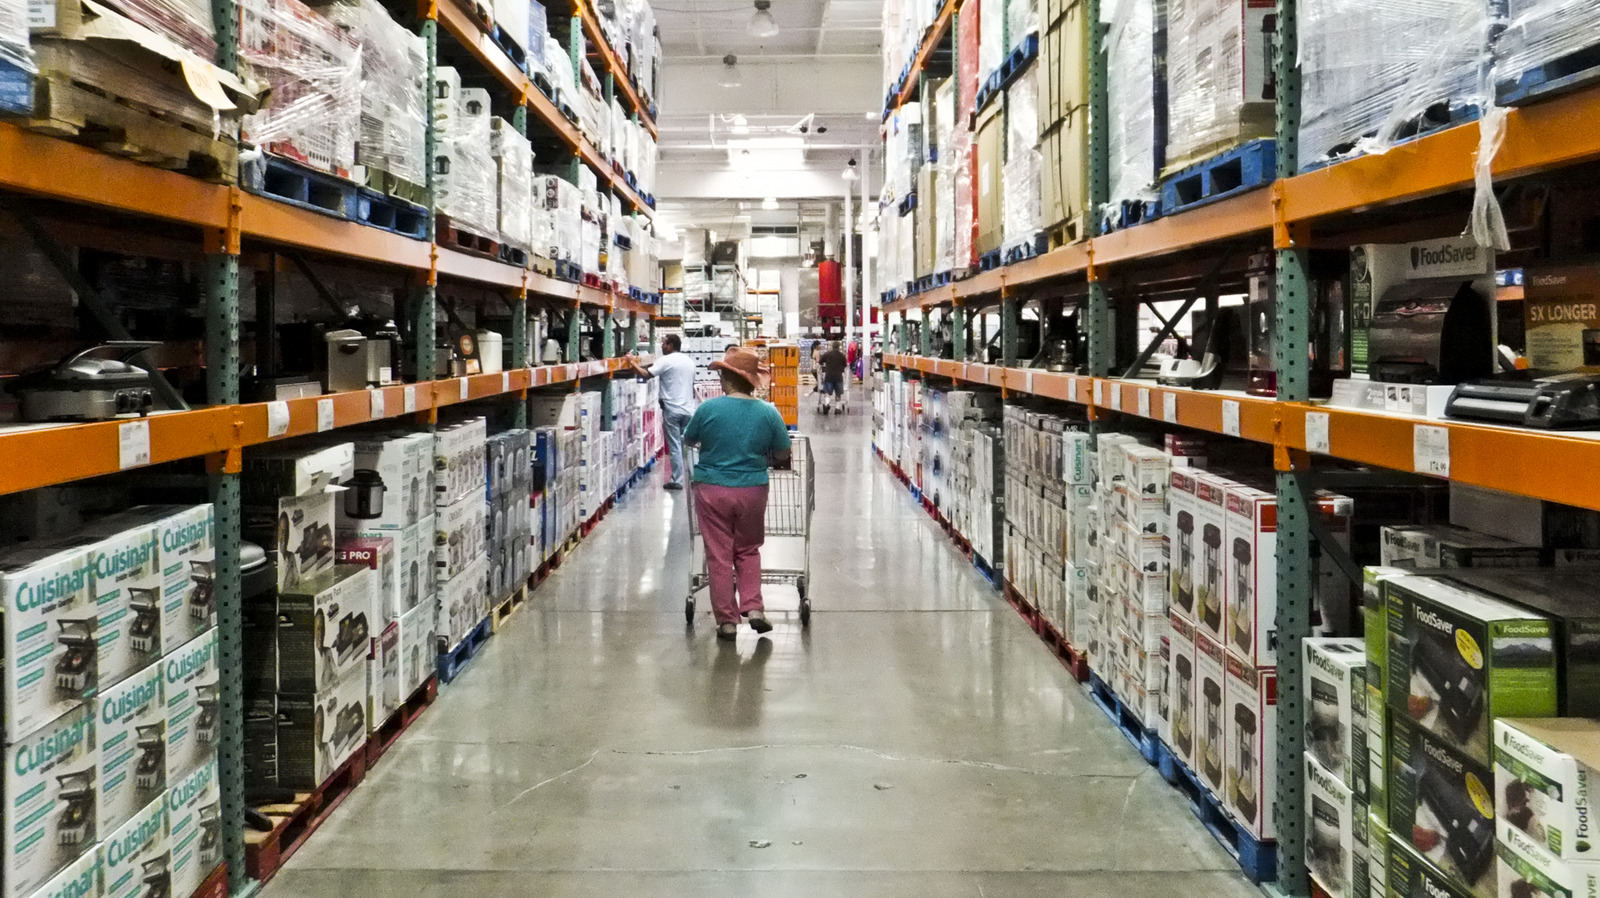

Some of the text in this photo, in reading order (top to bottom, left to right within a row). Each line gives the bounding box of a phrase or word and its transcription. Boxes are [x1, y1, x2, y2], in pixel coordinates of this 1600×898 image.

[1421, 244, 1477, 265] FoodSaver
[1532, 275, 1567, 286] FoodSaver
[1548, 304, 1596, 320] LONGER
[1073, 438, 1082, 482] Cuisinart
[162, 516, 215, 553] Cuisinart
[1390, 533, 1420, 552] FoodSaver
[96, 538, 159, 580] Cuisinart
[349, 550, 371, 560] PRO
[15, 562, 97, 612] Cuisinart
[1416, 605, 1454, 634] FoodSaver
[1503, 624, 1549, 634] FoodSaver
[167, 636, 219, 684] Cuisinart
[1312, 648, 1345, 682] FoodSaver
[102, 671, 164, 724] Cuisinart
[14, 712, 96, 776] Cuisinart
[1423, 738, 1463, 774] FoodSaver
[1508, 735, 1545, 766] FoodSaver
[1313, 766, 1347, 806] FoodSaver
[1576, 769, 1589, 839] FoodSaver
[108, 799, 169, 867] Cuisinart
[1513, 833, 1551, 867] FoodSaver
